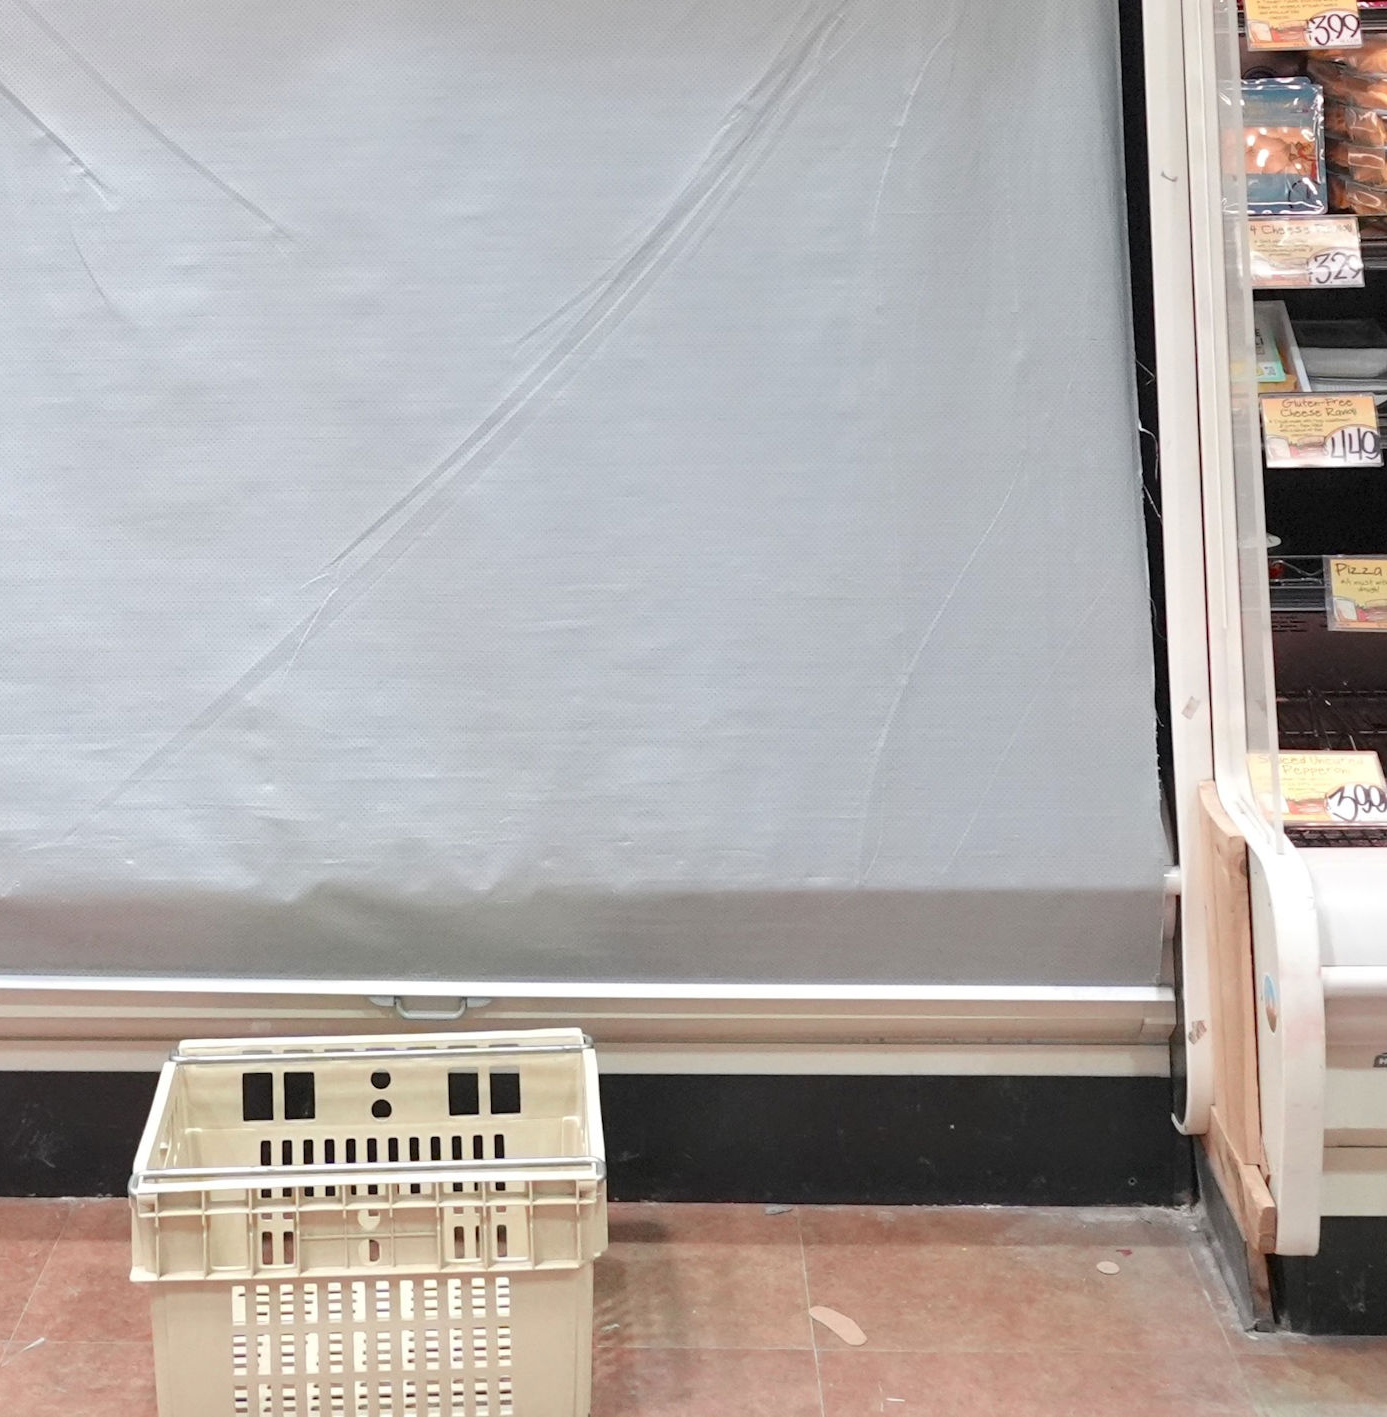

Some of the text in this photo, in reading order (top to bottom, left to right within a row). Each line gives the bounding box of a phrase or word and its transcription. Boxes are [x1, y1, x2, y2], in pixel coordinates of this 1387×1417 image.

[1281, 398, 1353, 408] Gluten-Free
[1279, 407, 1323, 418] Cheese
[1335, 563, 1384, 577] Pizza
